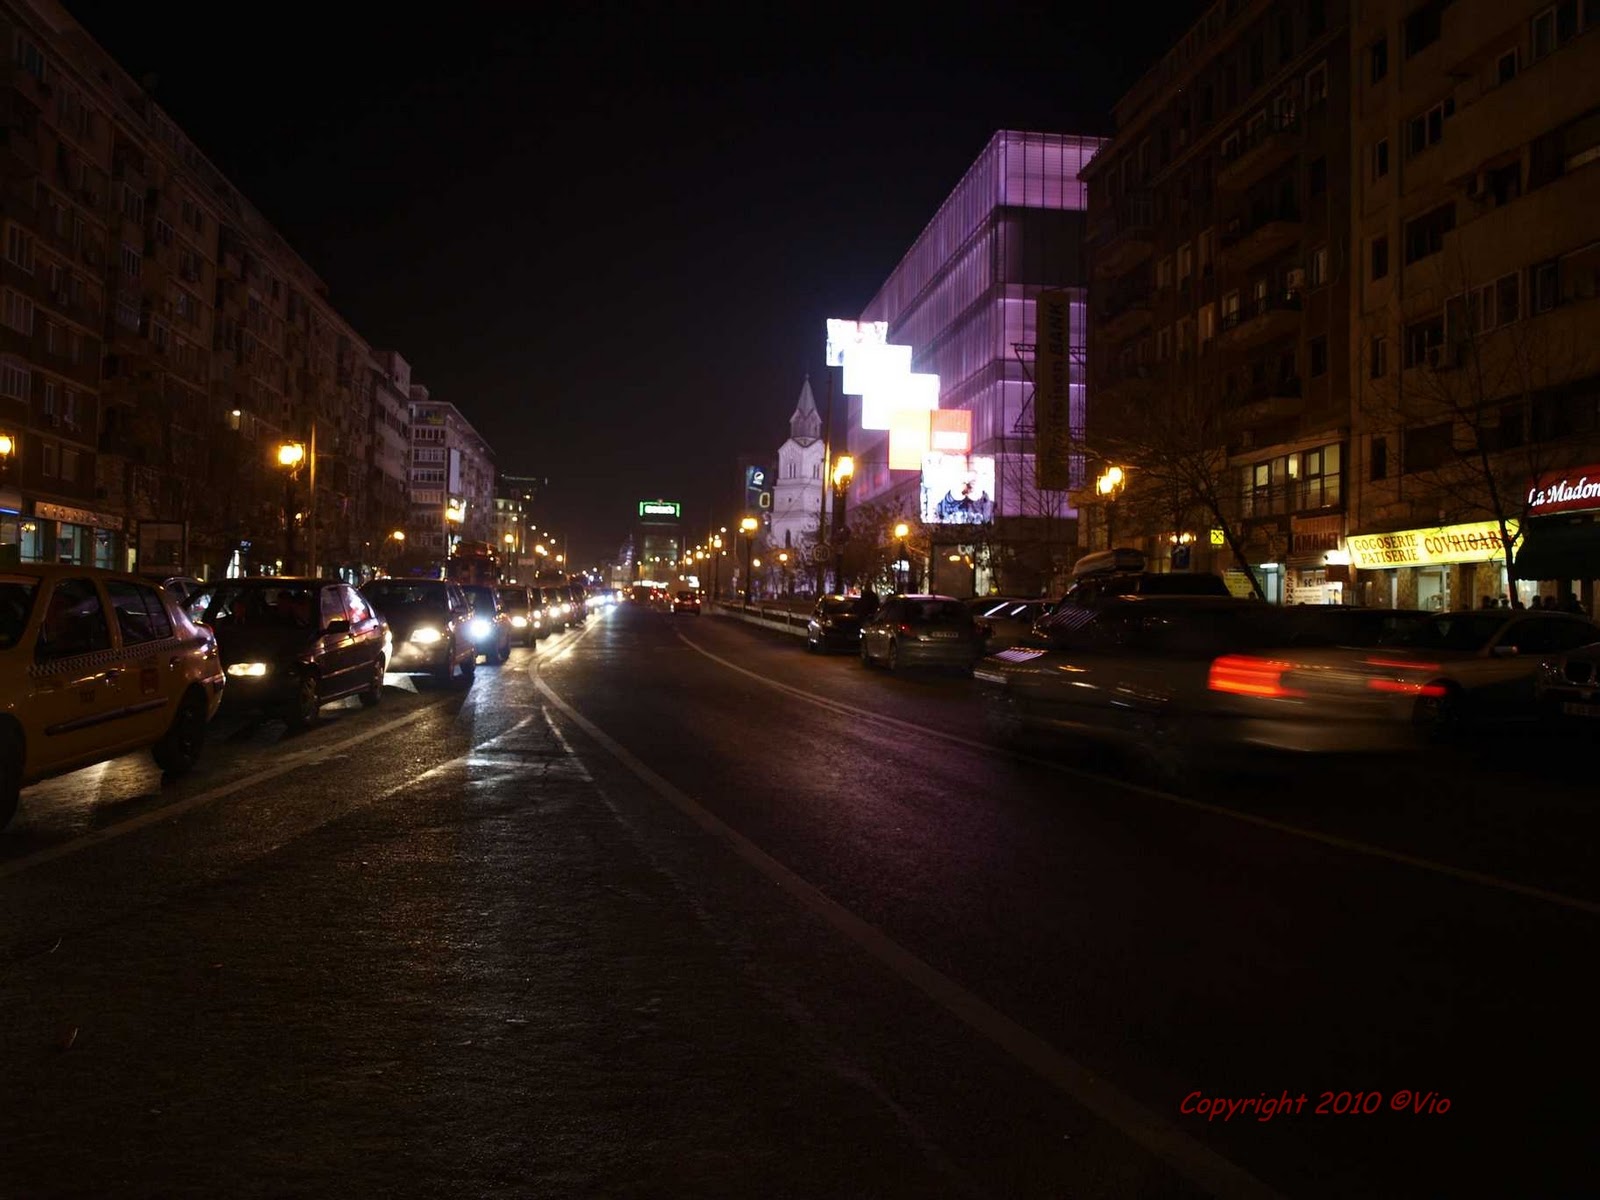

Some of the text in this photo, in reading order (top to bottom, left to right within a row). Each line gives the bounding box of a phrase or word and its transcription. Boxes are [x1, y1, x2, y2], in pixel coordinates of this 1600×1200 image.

[1047, 302, 1064, 356] BANK
[1527, 488, 1546, 507] La
[1354, 533, 1418, 552] GOGOSERIE
[815, 547, 829, 559] 60
[1361, 549, 1420, 565] PATISERIE
